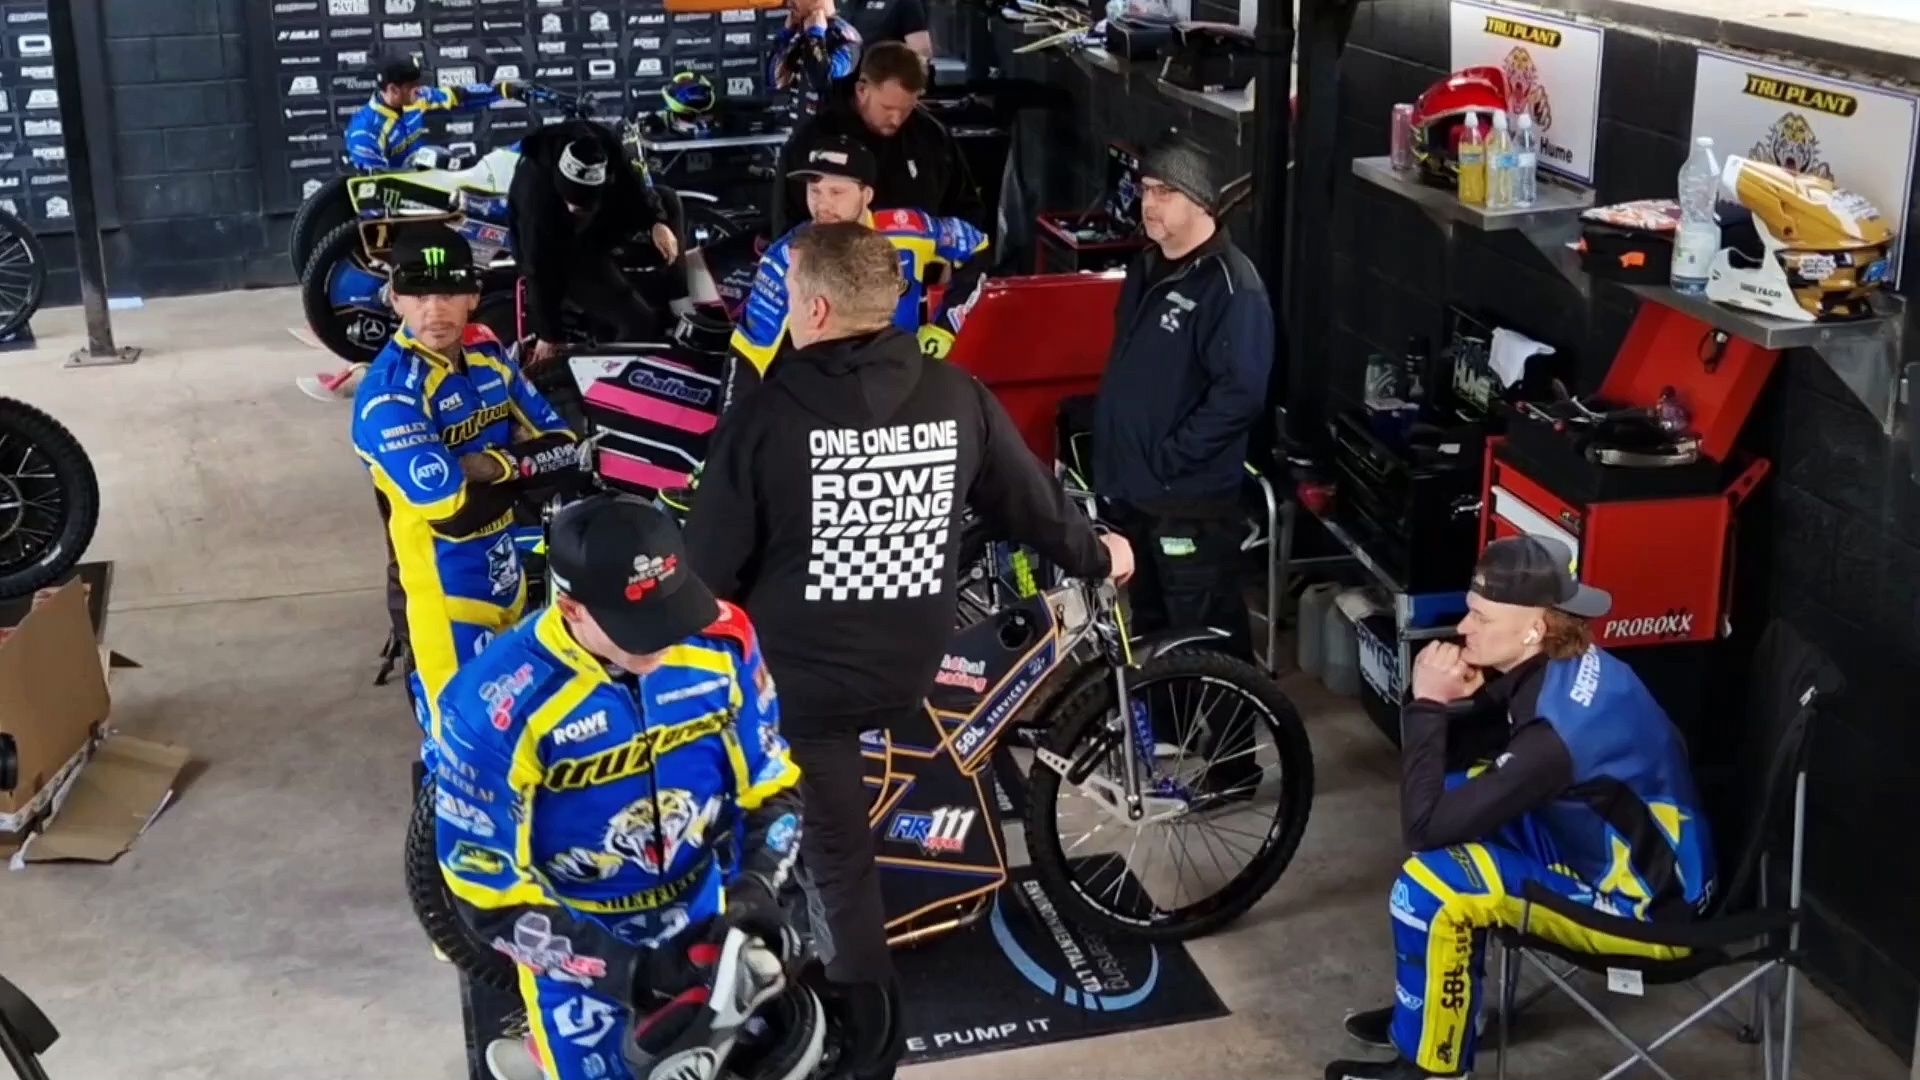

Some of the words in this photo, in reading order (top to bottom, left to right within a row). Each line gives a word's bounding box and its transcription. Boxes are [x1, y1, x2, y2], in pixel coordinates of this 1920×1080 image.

[1487, 19, 1512, 36] TRU
[1512, 24, 1558, 45] PLANT
[1749, 76, 1785, 98] TRU
[1785, 86, 1852, 114] PLANT
[1539, 136, 1573, 164] Hume
[809, 429, 860, 456] ONE
[862, 425, 910, 455] ONE
[913, 419, 958, 450] ONE
[812, 464, 956, 500] ROWE
[812, 491, 953, 526] RACING
[1603, 613, 1694, 639] PROBOXX
[986, 679, 1029, 726] SERVICES
[552, 710, 608, 745] ROWE
[1075, 970, 1103, 994] LTD
[933, 1022, 1018, 1050] PUMP
[1027, 1017, 1051, 1034] IT
